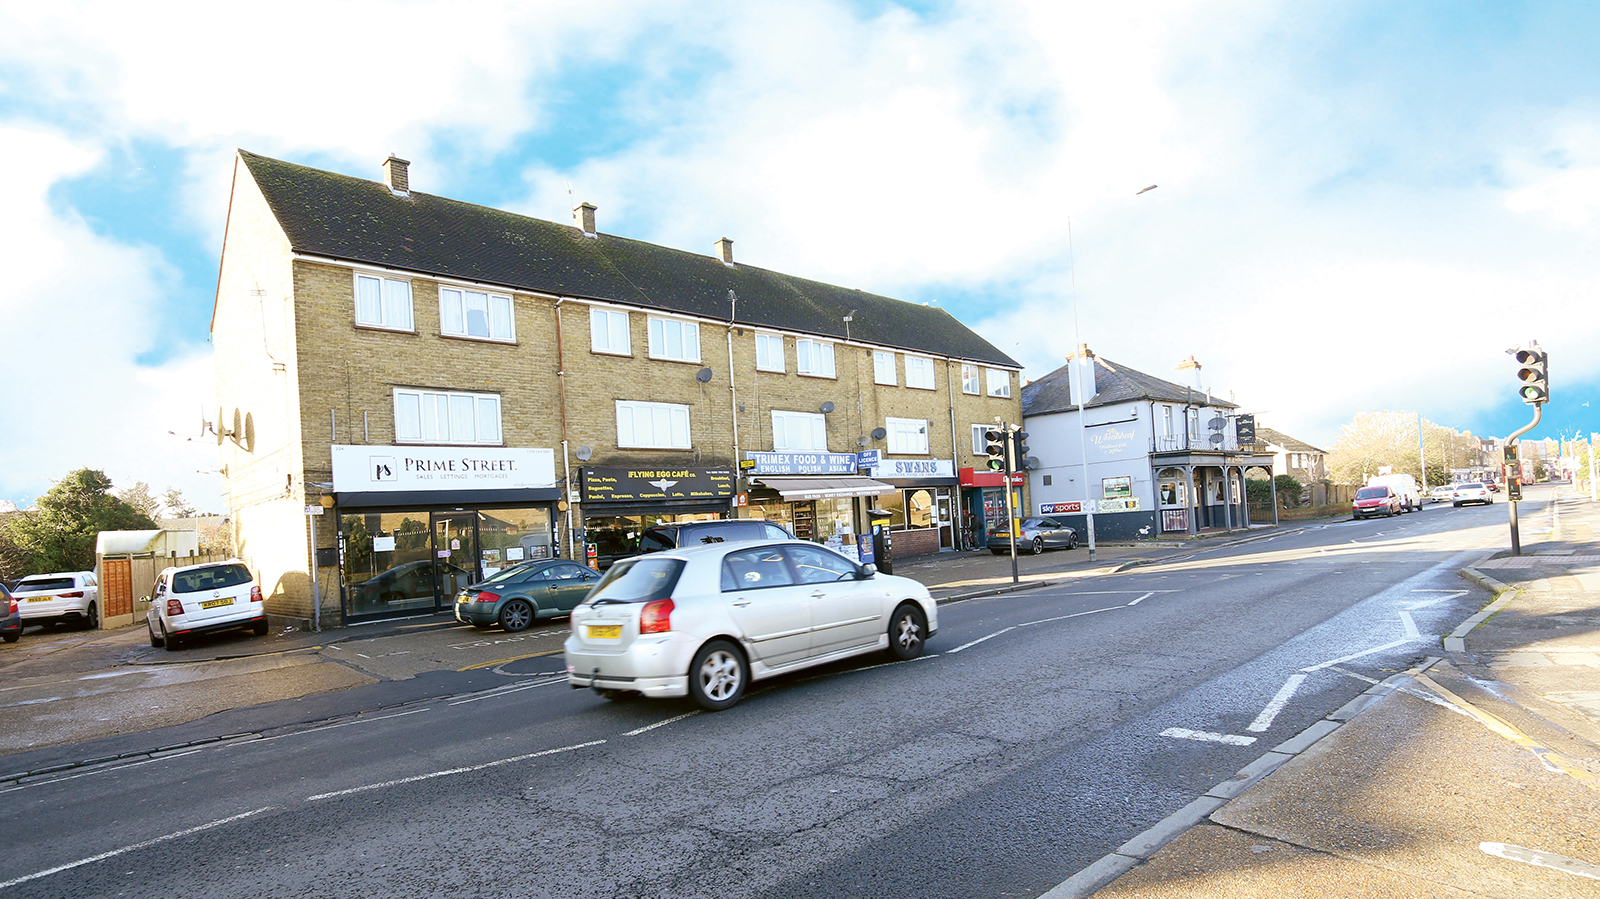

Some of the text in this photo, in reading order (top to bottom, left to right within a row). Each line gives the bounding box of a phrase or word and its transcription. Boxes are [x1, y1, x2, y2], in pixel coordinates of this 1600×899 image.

[1090, 429, 1135, 445] Wheatsheaf
[404, 457, 456, 472] PRIME
[754, 454, 790, 464] TRIMEX
[793, 454, 817, 465] FOOD
[820, 454, 826, 464] &
[828, 455, 851, 465] WINE
[760, 465, 790, 473] ENGLISH
[798, 465, 822, 473] POLISH
[895, 461, 938, 473] SWANS
[1041, 504, 1054, 513] sky
[1055, 503, 1080, 513] sports
